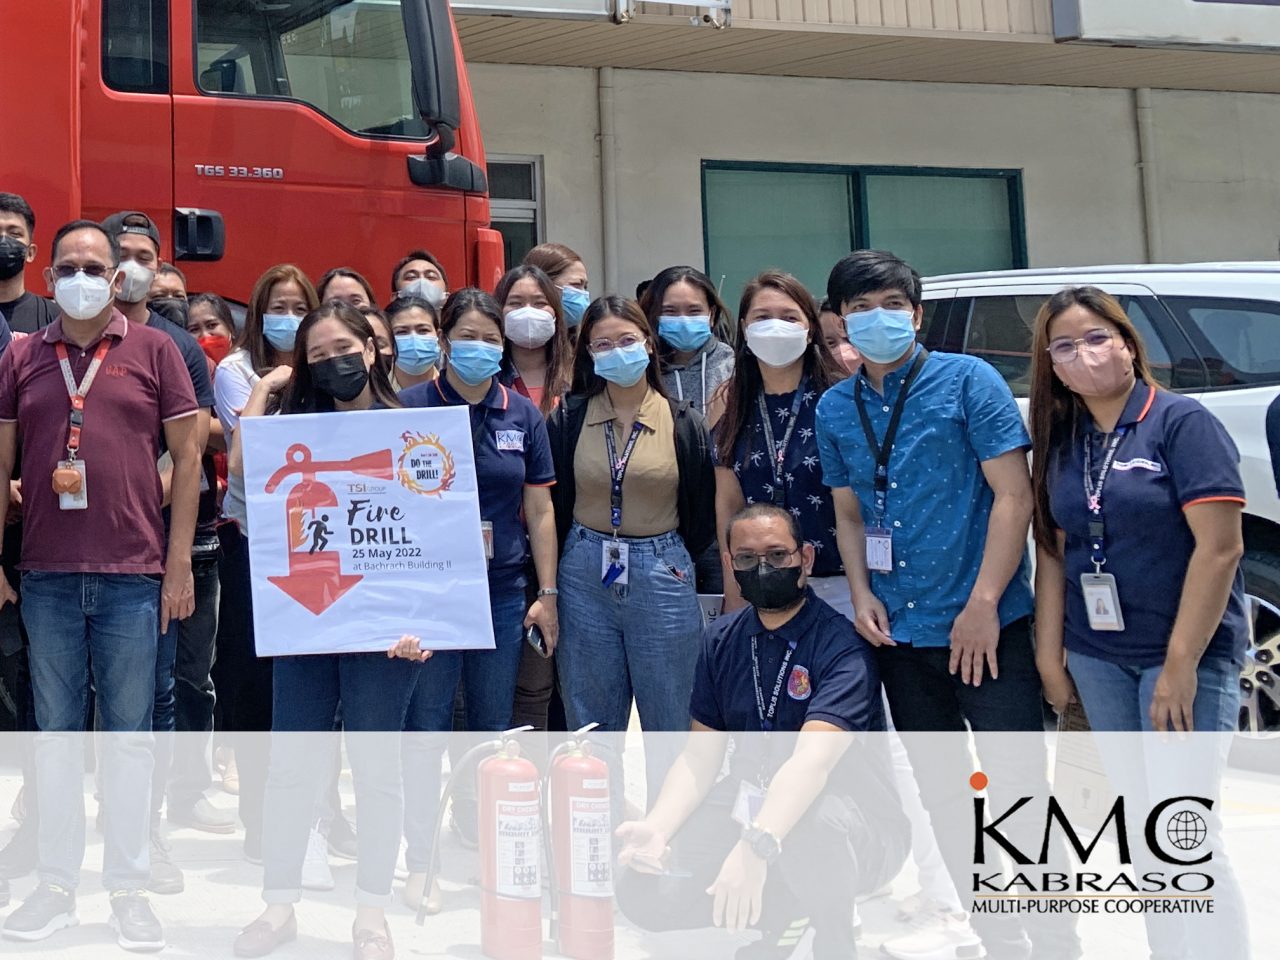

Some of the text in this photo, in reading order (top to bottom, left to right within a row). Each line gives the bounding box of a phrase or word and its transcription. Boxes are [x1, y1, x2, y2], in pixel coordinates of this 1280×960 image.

[194, 164, 284, 179] TGS 33.360
[410, 458, 420, 468] DO
[416, 469, 439, 480] DRILL!
[347, 483, 367, 493] TSI
[347, 499, 405, 526] Fire
[350, 527, 412, 546] DRILL
[352, 547, 422, 561] 25 May 2022
[352, 563, 362, 571] at
[364, 561, 405, 571] Bachrach
[407, 560, 444, 571] Building
